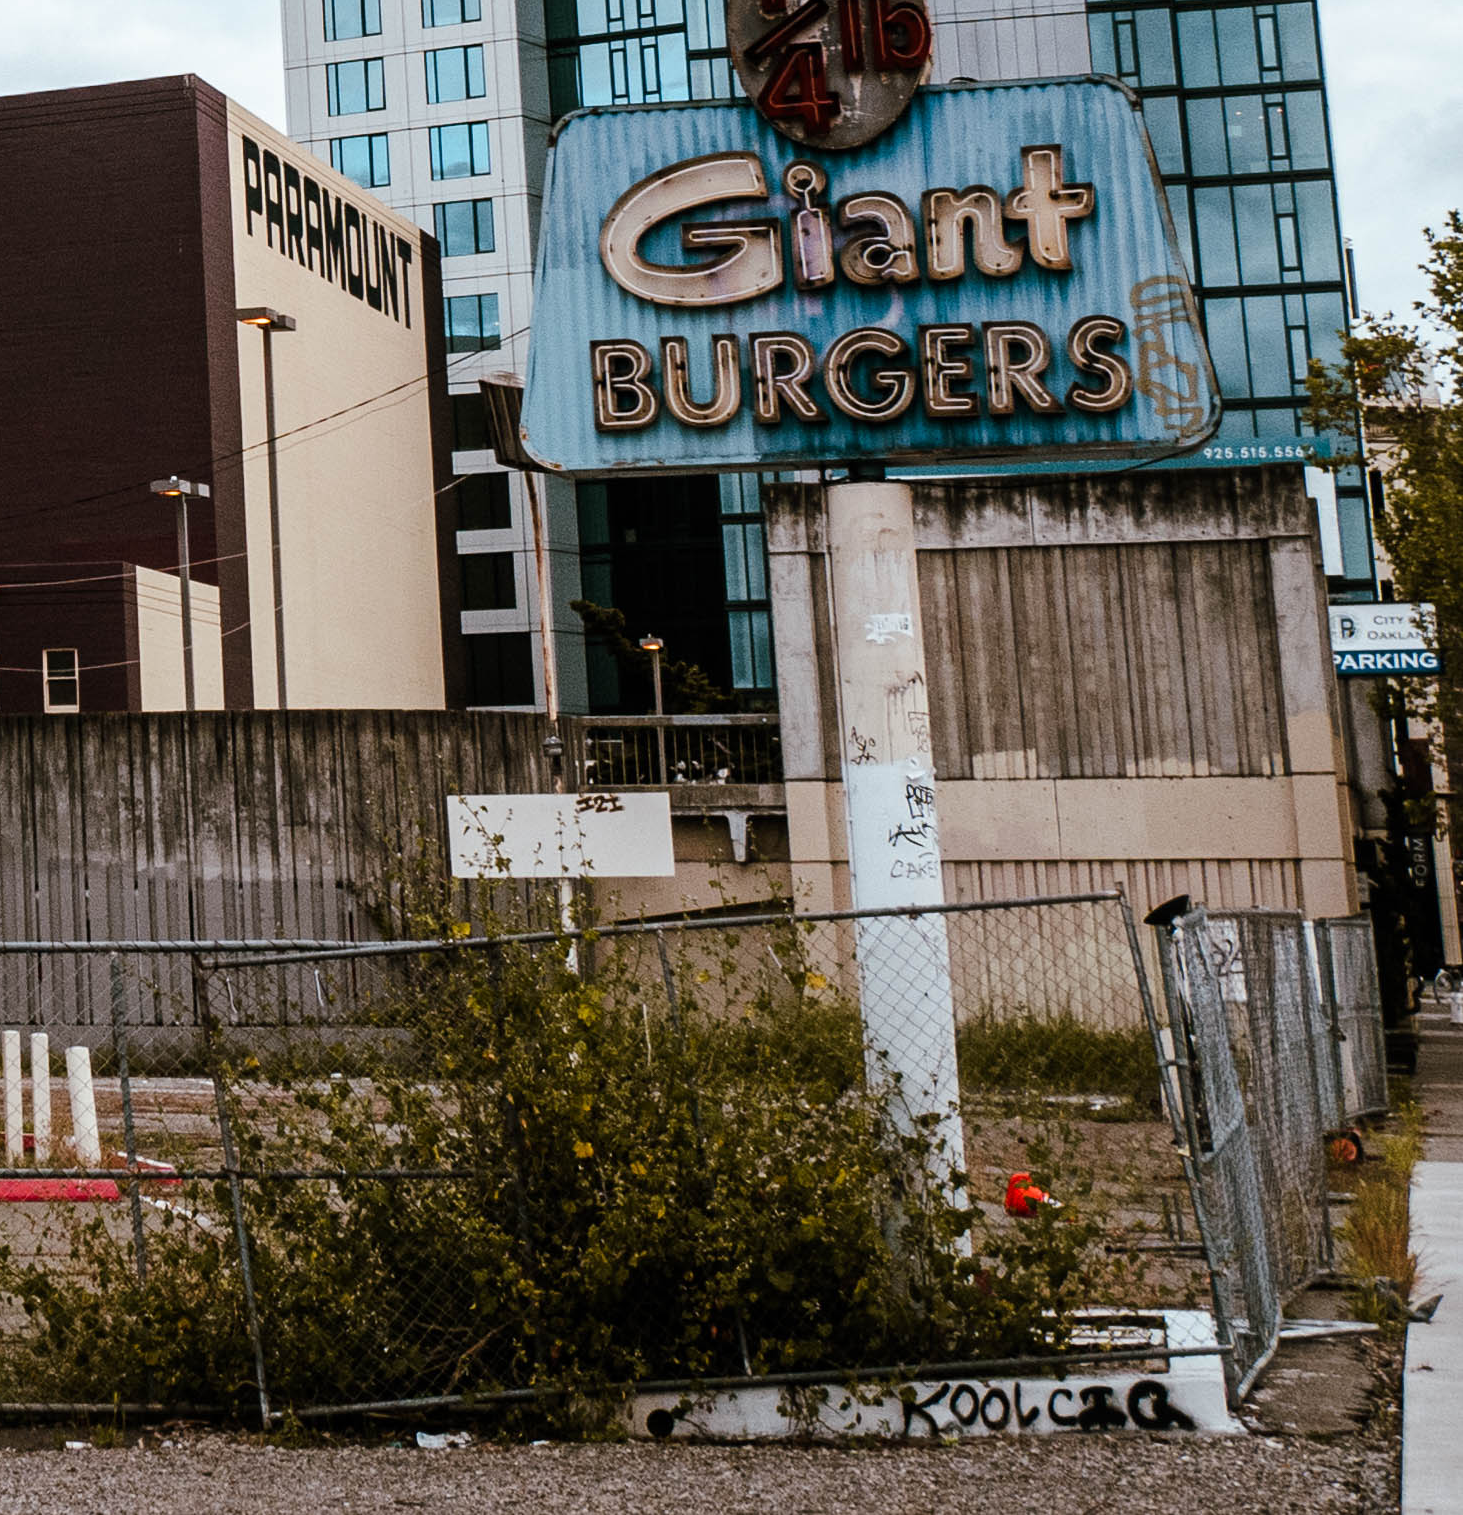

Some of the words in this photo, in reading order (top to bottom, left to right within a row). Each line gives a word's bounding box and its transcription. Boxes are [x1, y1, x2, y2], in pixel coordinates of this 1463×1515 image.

[242, 133, 412, 330] PARAMOUNT
[599, 144, 1095, 307] Giant
[590, 315, 1133, 432] BURGERS
[1332, 652, 1438, 670] PARKING
